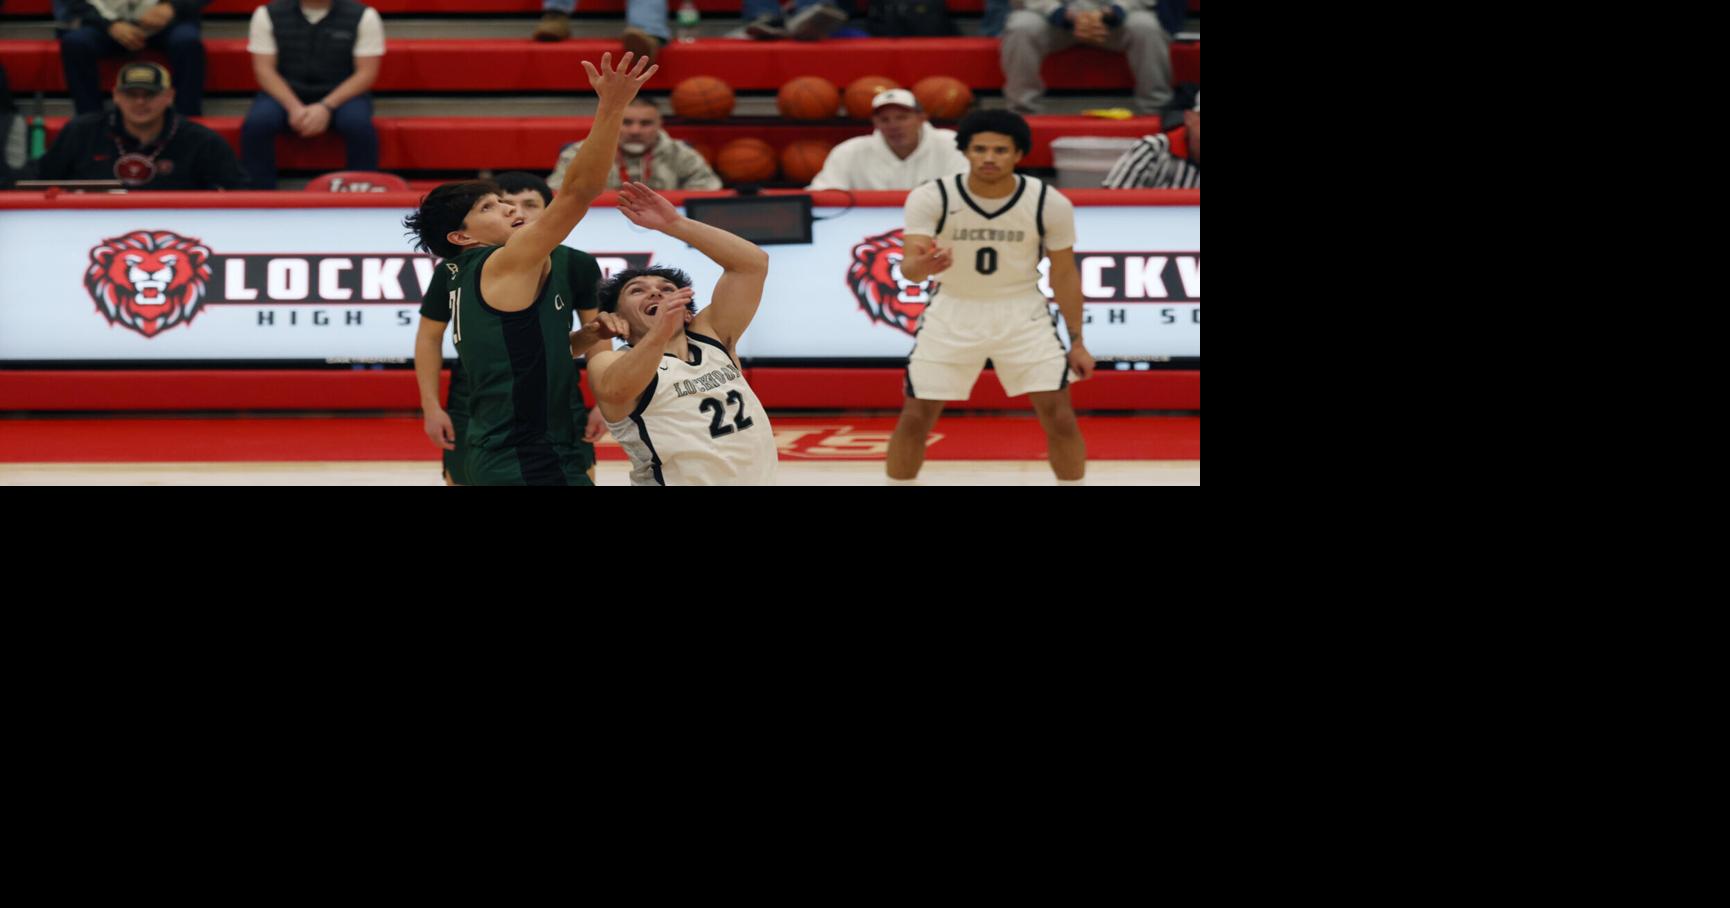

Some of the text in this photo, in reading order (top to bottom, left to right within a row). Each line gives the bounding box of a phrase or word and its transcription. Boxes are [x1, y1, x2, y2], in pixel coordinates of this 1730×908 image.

[952, 228, 1025, 242] LOCKWOOD
[975, 247, 998, 275] 0
[257, 310, 363, 326] HIGH
[699, 389, 754, 439] 22
